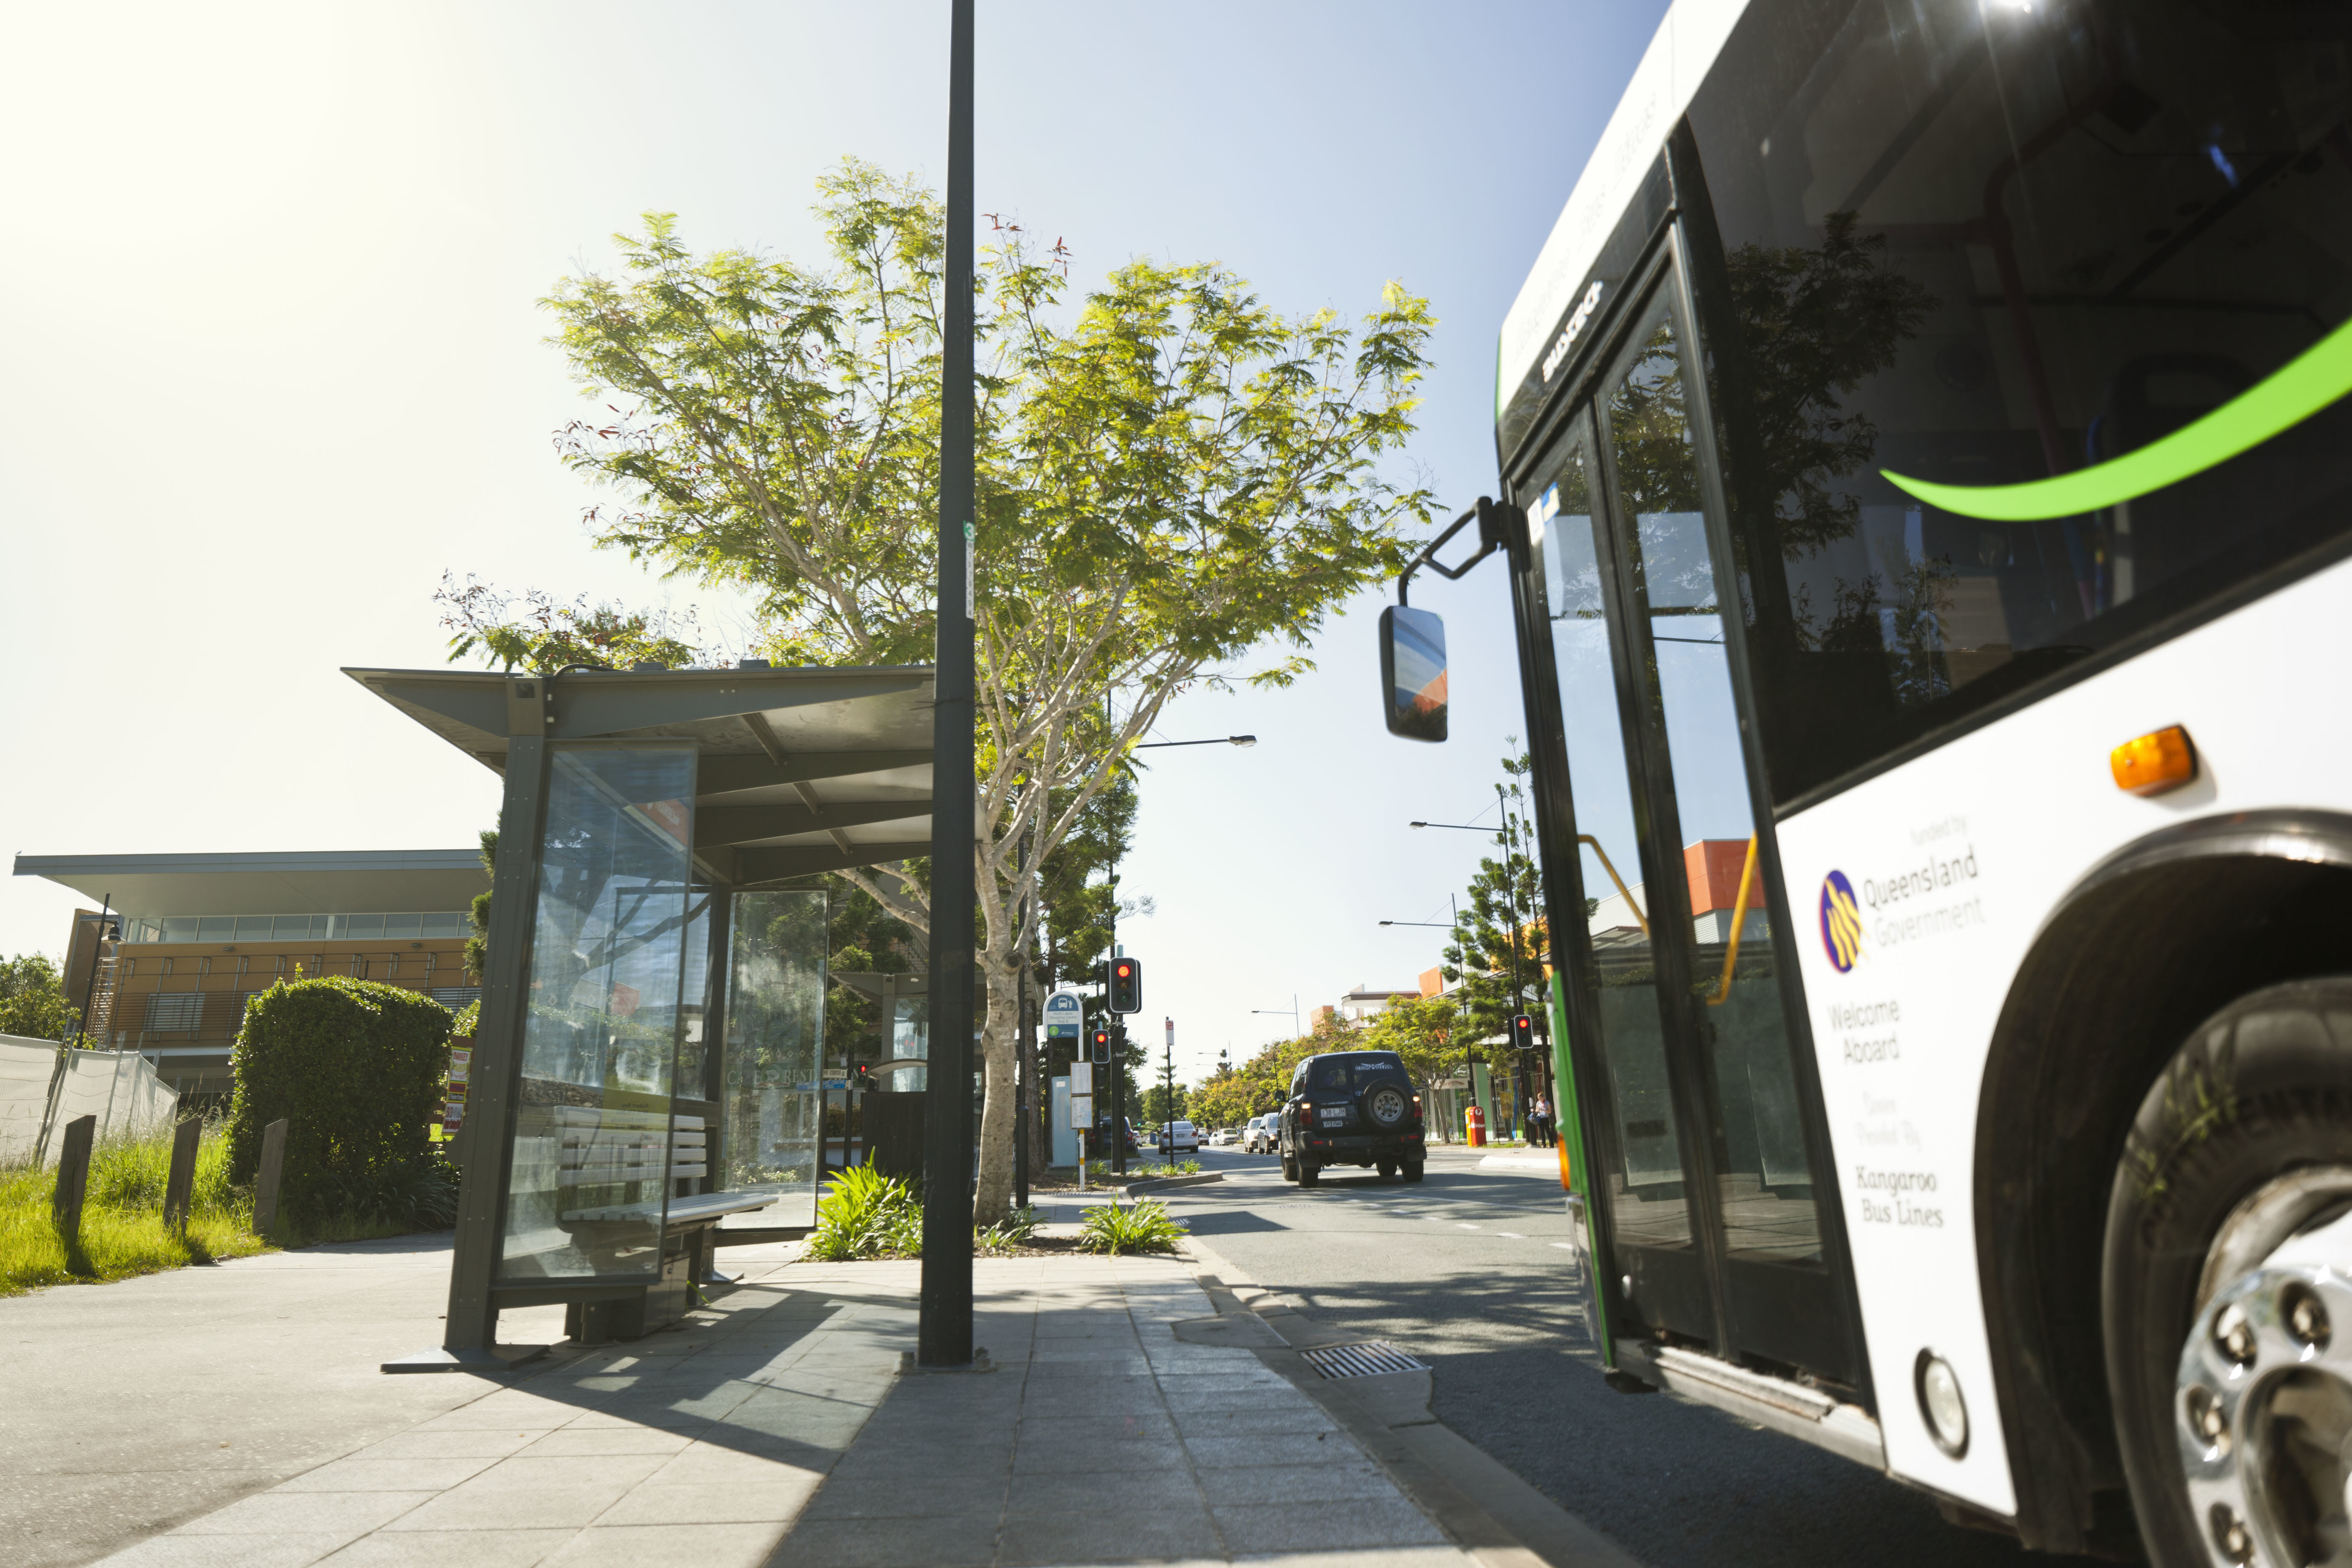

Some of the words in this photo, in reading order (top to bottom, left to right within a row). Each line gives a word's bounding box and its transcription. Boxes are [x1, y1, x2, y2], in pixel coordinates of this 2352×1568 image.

[965, 522, 975, 540] 3
[1864, 845, 1978, 911] Queensland
[1874, 896, 1986, 948] Government
[1829, 1000, 1900, 1030] Welcome
[1844, 1033, 1900, 1064] Aboard
[1855, 1165, 1938, 1198] Kangaroo
[1861, 1199, 1892, 1224] Bus
[1896, 1199, 1944, 1228] Lines
